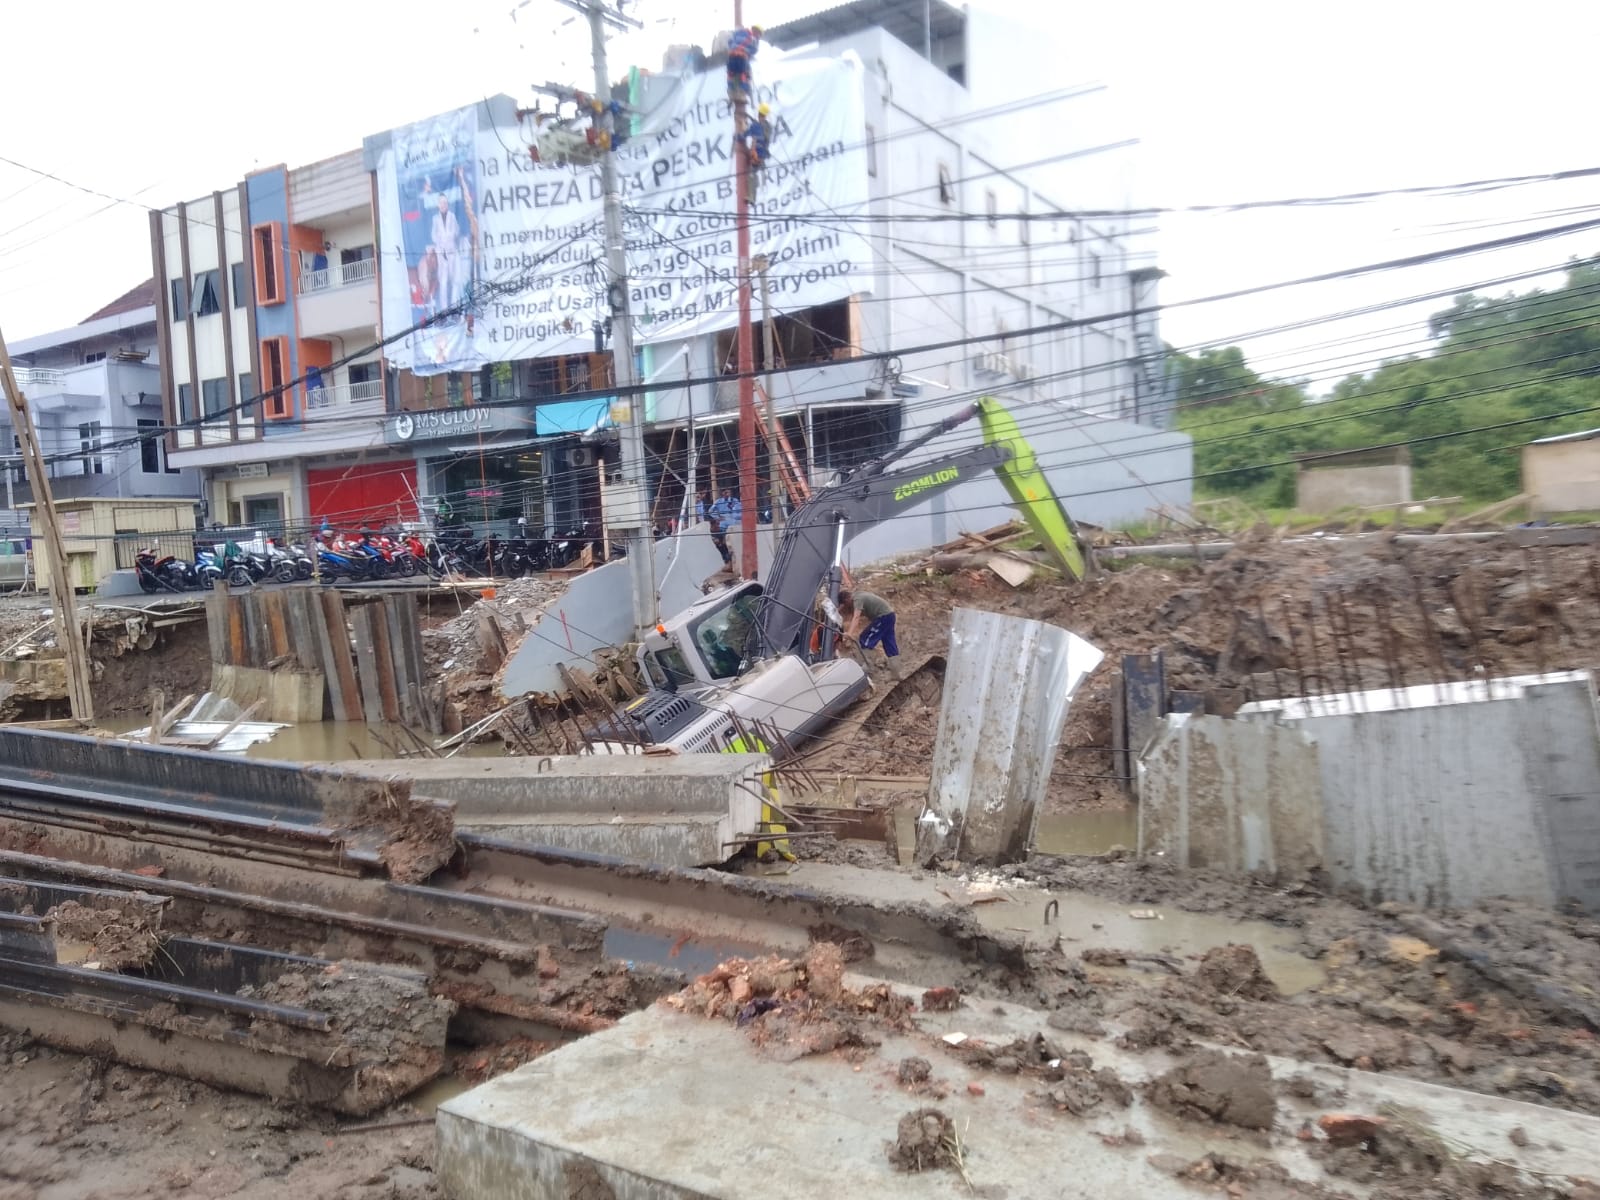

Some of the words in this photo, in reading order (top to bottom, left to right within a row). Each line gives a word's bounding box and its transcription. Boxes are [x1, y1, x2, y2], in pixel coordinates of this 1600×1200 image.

[481, 178, 582, 214] AHREZA
[589, 170, 648, 201] DTA
[651, 114, 793, 187] PERKA
[493, 299, 553, 319] Tempat
[630, 280, 673, 302] ang
[503, 319, 583, 343] Dirugikn
[440, 407, 491, 426] GLOW
[893, 465, 959, 502] ZOOMLION
